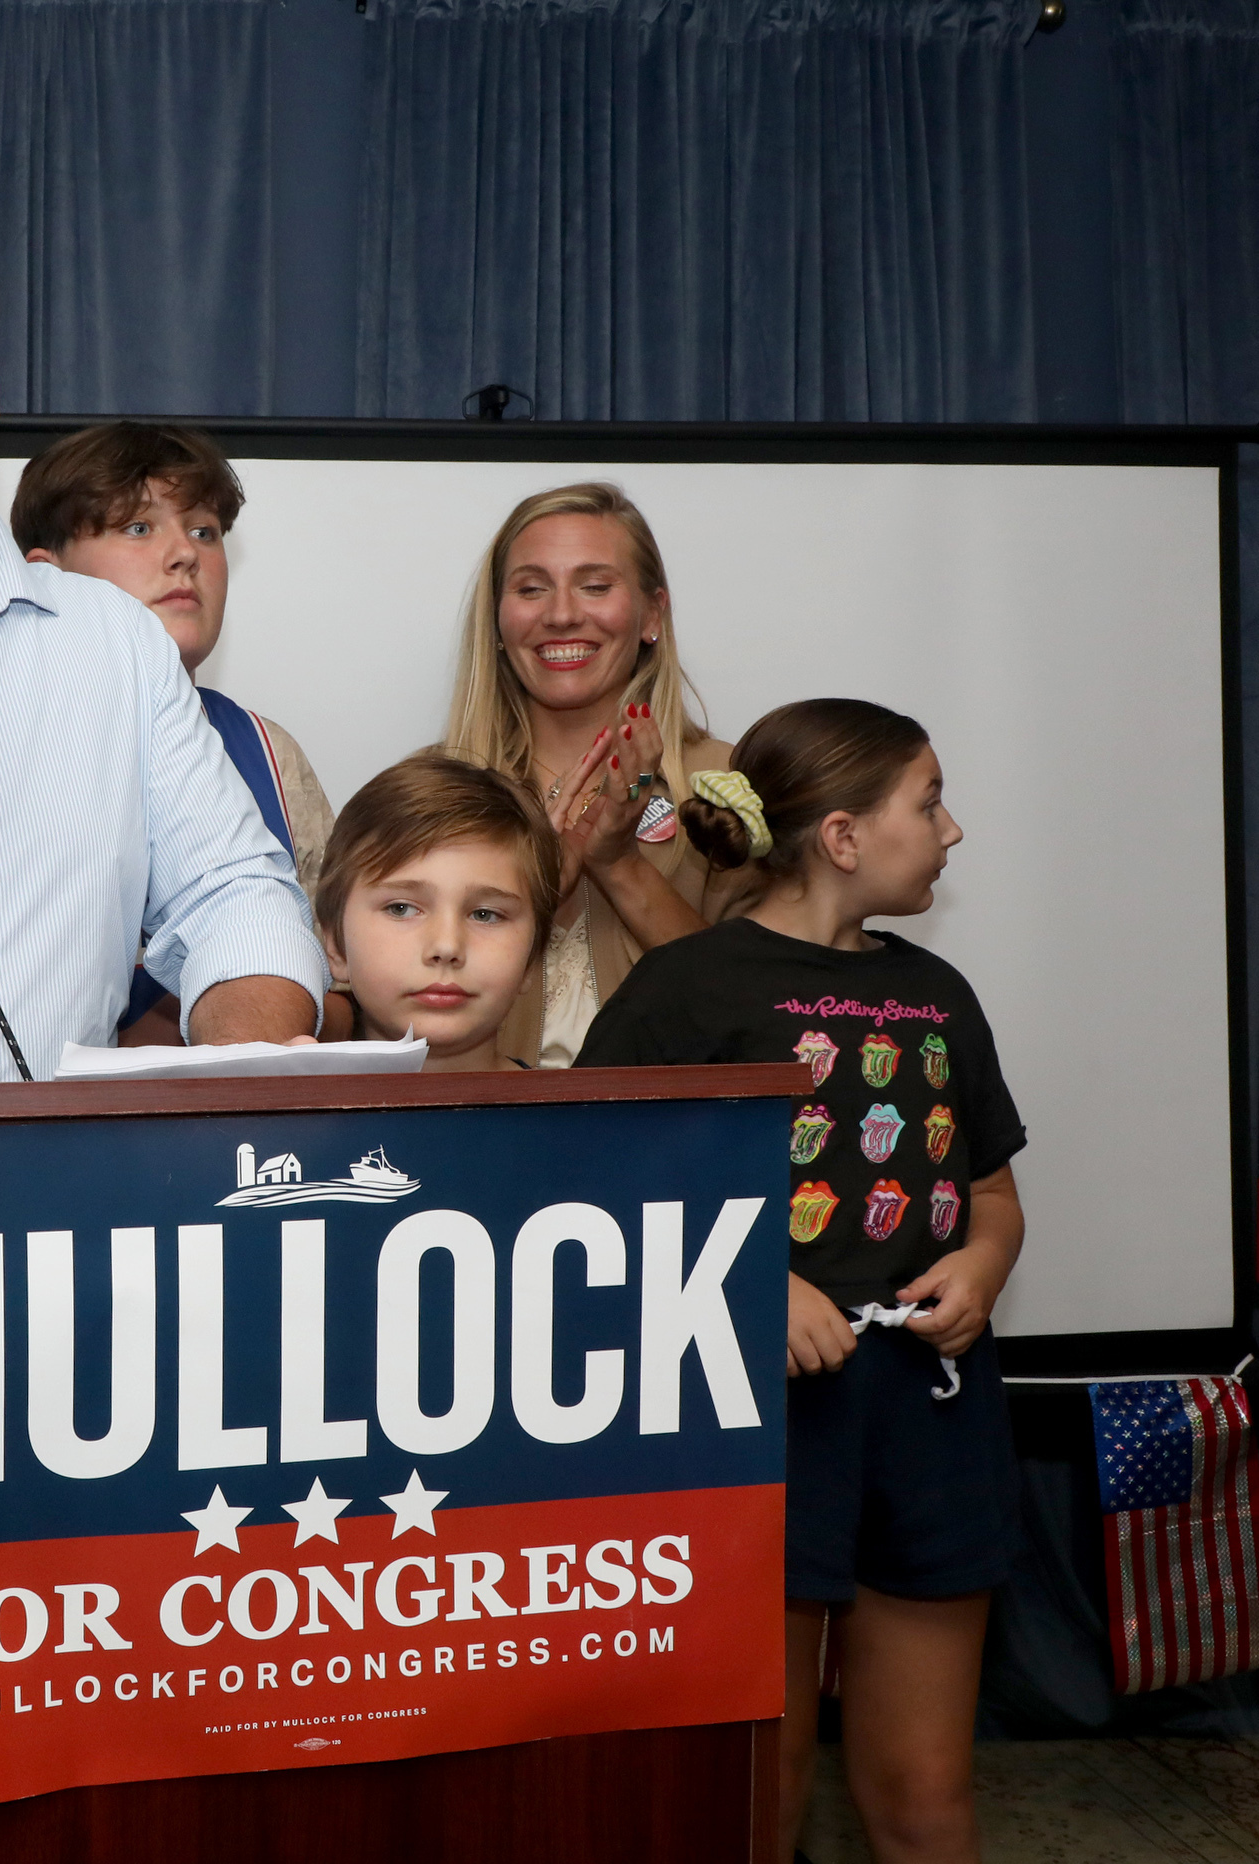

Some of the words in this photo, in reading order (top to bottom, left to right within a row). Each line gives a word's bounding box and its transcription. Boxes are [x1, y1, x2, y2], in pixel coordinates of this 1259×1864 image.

[809, 995, 885, 1027] Rolling
[884, 999, 950, 1024] Stones
[159, 1534, 694, 1647] CONGRESS
[205, 1725, 232, 1735] PAID
[237, 1722, 259, 1731] FOR
[263, 1720, 277, 1730] BY
[282, 1715, 336, 1728] MULLOCK
[341, 1713, 363, 1723] FOR
[367, 1707, 428, 1721] CONGRESS
